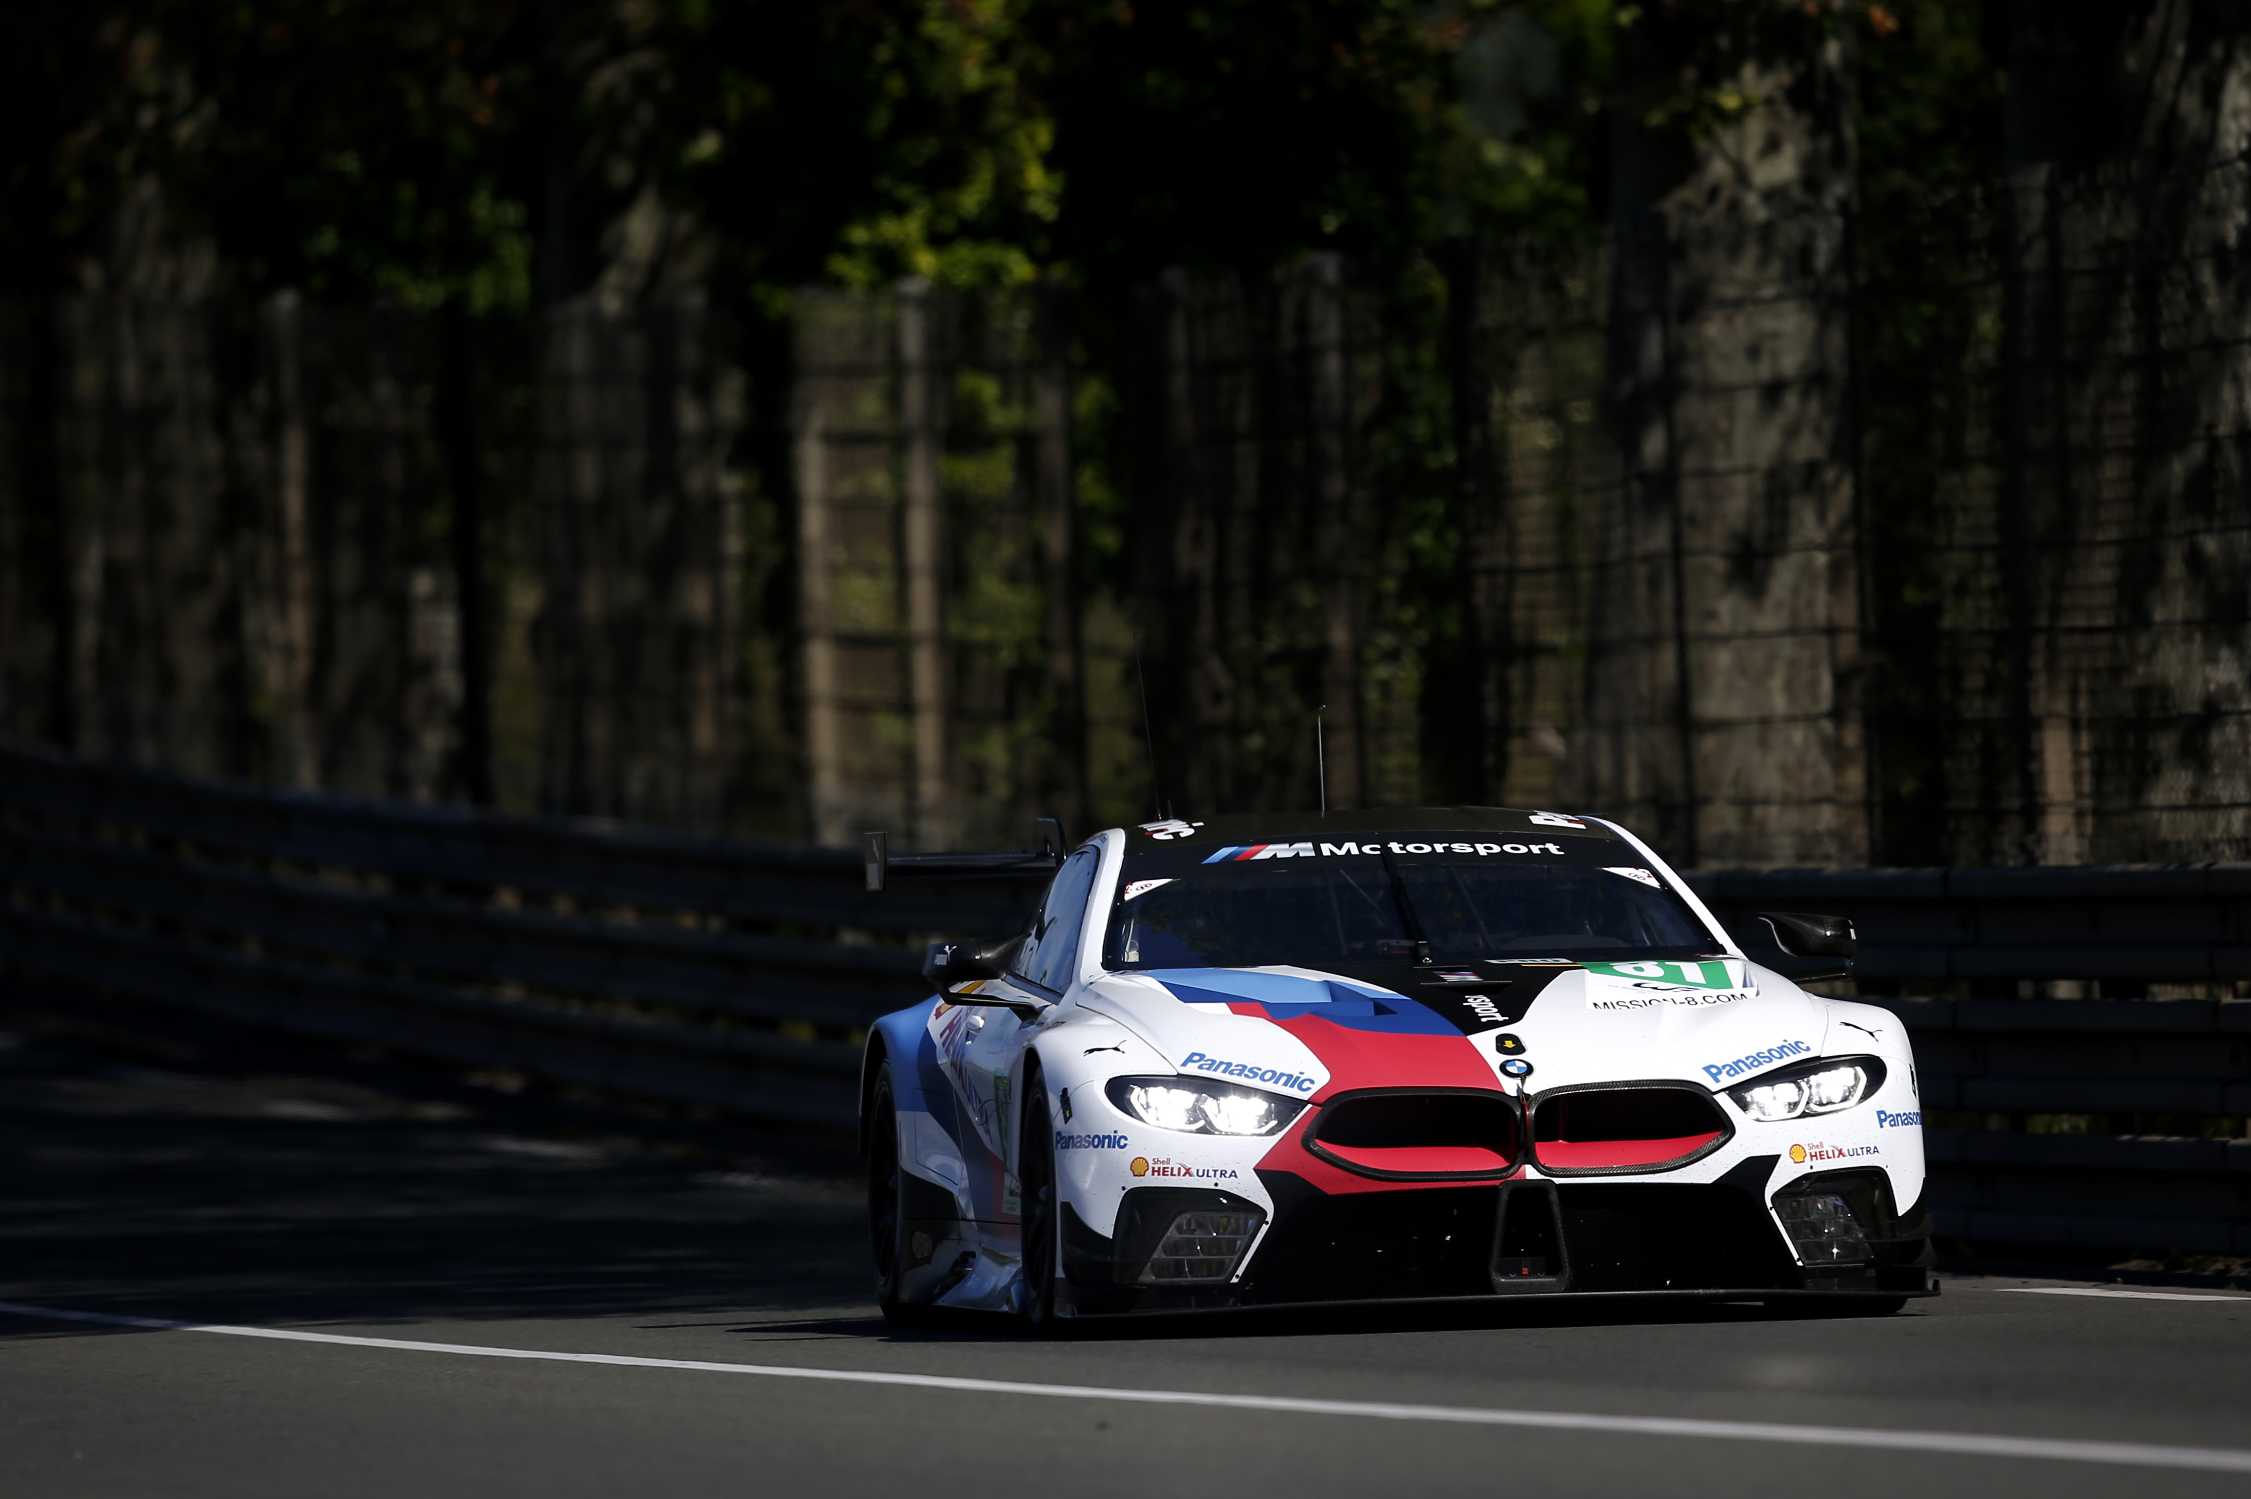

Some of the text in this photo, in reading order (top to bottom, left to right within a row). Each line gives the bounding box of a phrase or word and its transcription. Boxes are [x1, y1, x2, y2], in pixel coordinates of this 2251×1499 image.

[1320, 841, 1566, 857] Motorsport
[1702, 1039, 1812, 1084] Panasonic
[1180, 1051, 1316, 1093] Panasonic
[1055, 1130, 1129, 1151] Panasonic
[1807, 1142, 1824, 1151] Shell
[1151, 1157, 1171, 1166] Shell
[1808, 1145, 1880, 1162] HELIX ULTRA
[1151, 1163, 1238, 1180] HELIX ULTRA
